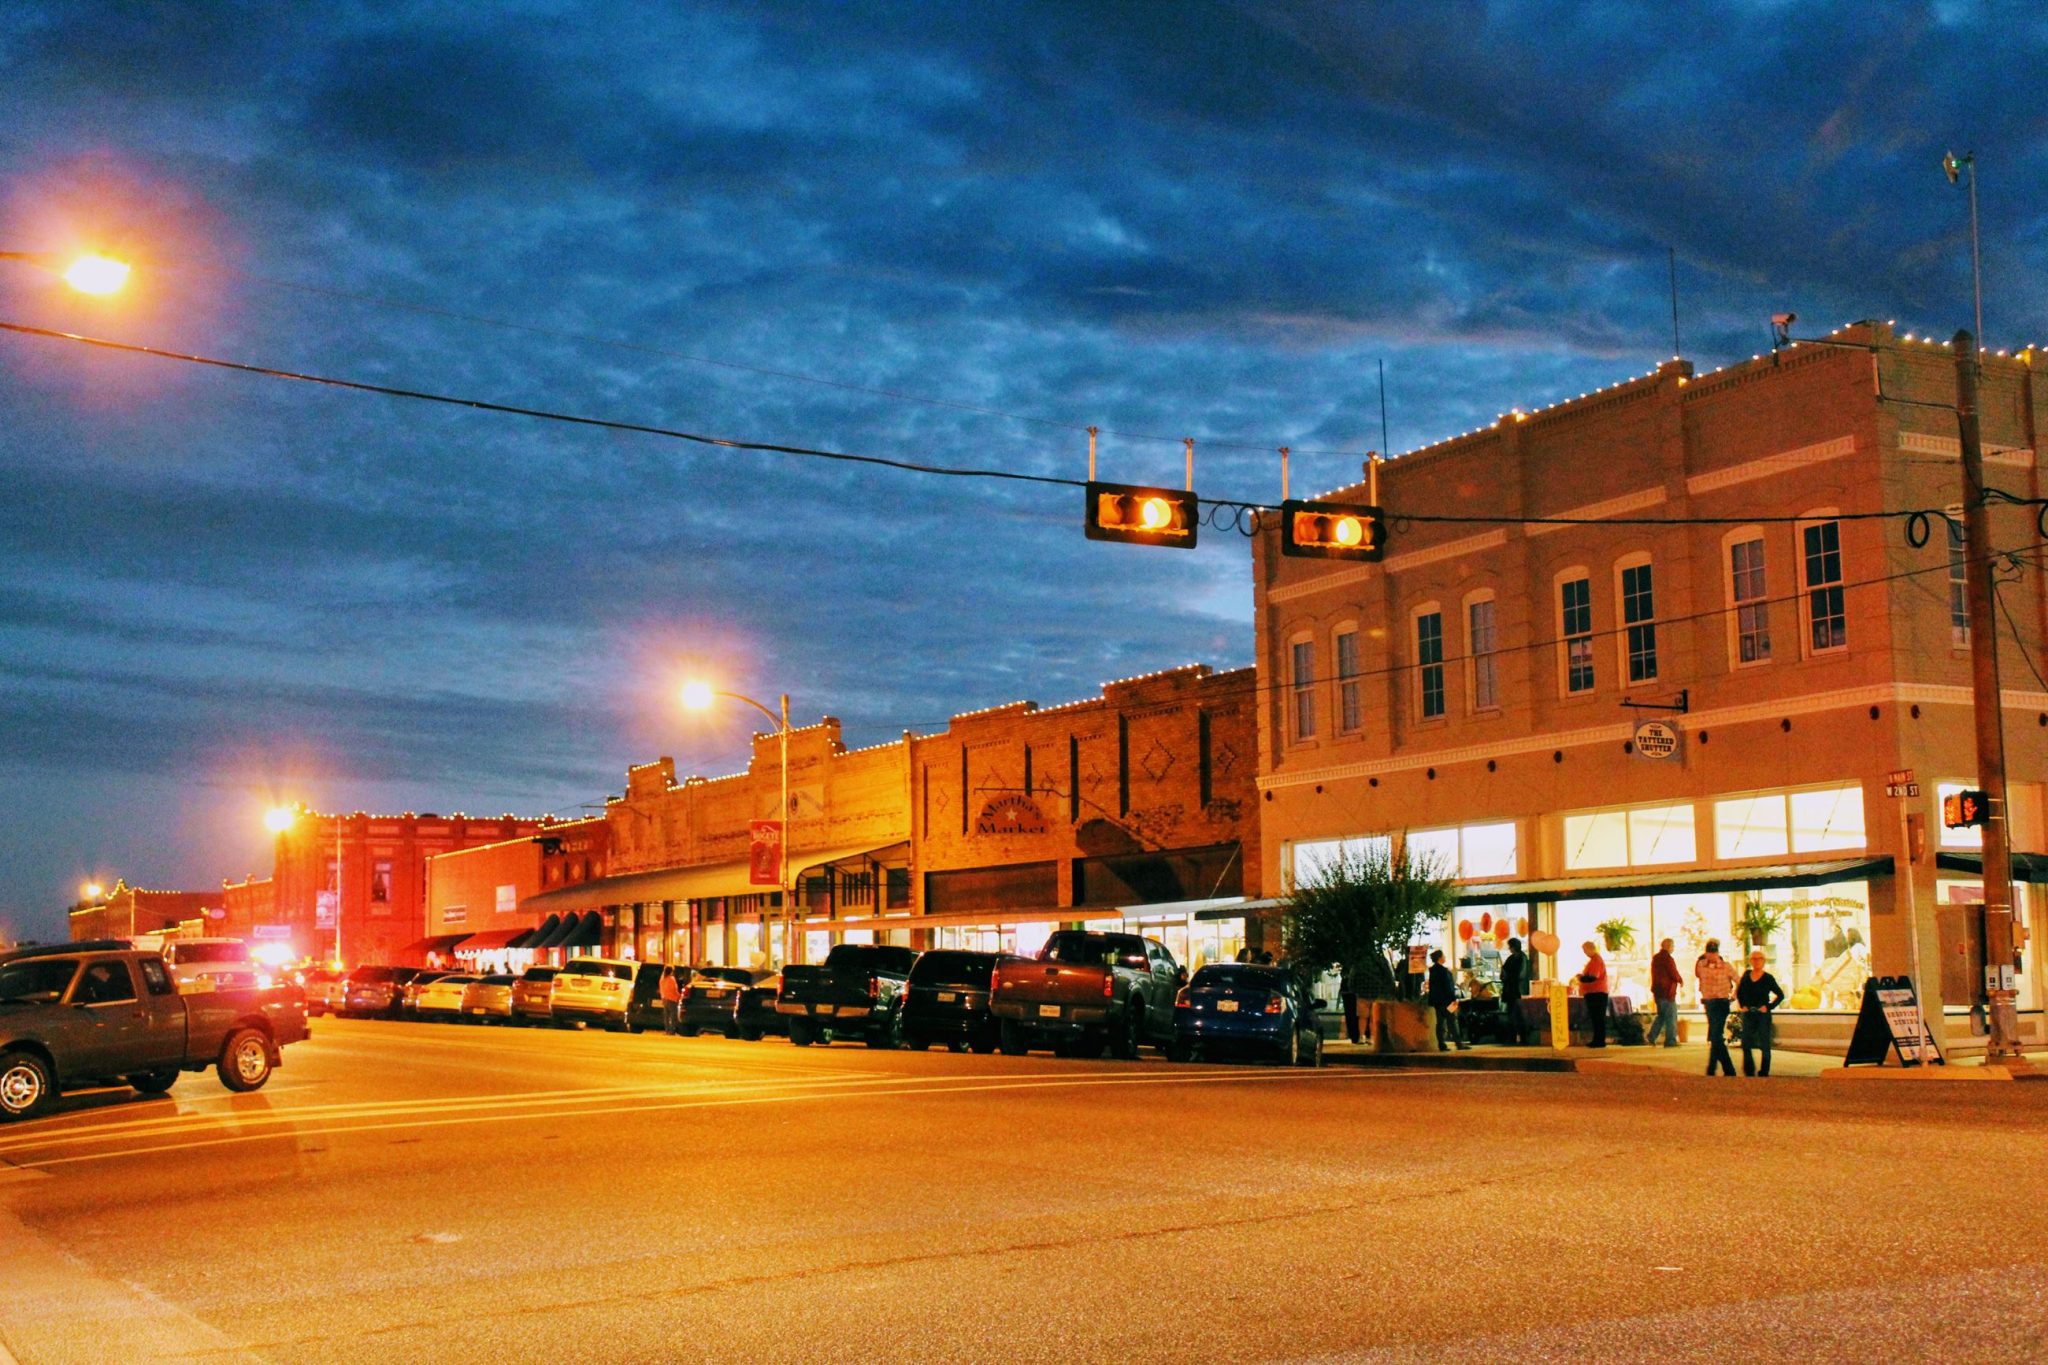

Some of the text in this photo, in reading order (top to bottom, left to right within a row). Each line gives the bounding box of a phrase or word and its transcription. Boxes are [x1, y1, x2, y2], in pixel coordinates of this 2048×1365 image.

[1649, 729, 1663, 737] THE
[1638, 736, 1675, 745] TATTERED
[1641, 744, 1672, 752] SHUTTER
[1894, 786, 1908, 796] 2ND
[1909, 785, 1919, 796] ST
[982, 795, 1042, 820] Martha's
[978, 822, 1045, 834] Market
[1554, 988, 1566, 1043] OPEN
